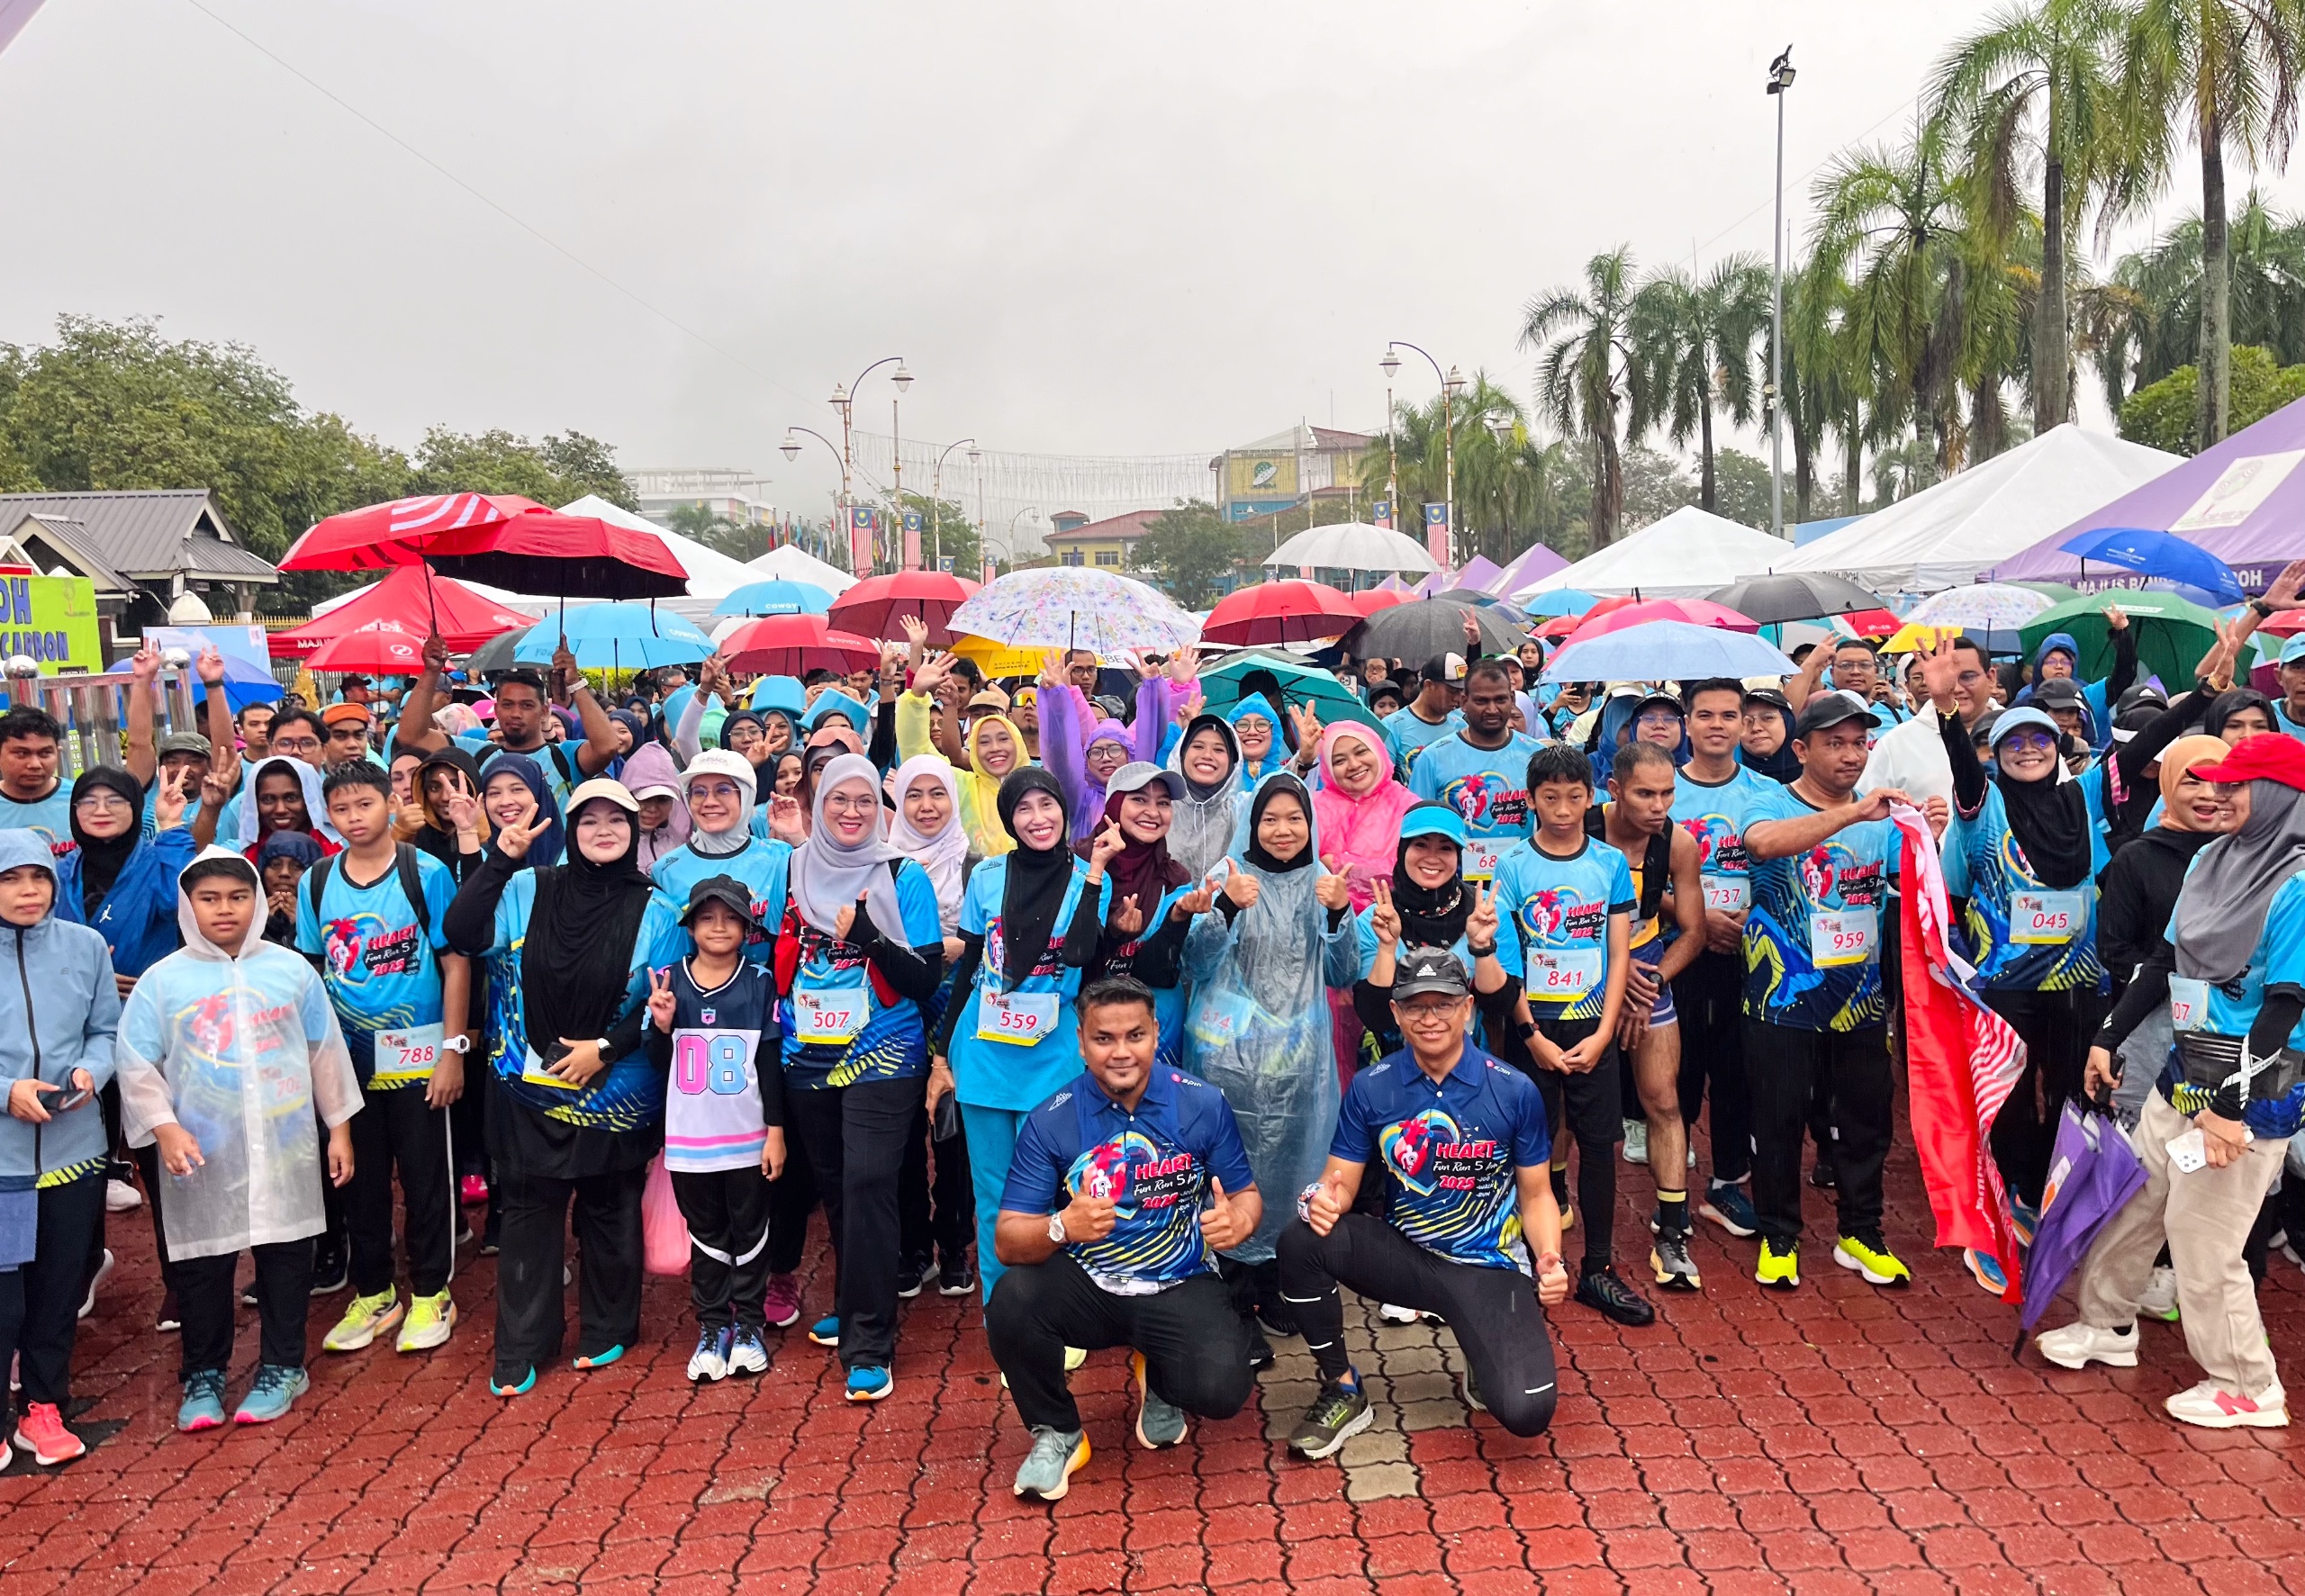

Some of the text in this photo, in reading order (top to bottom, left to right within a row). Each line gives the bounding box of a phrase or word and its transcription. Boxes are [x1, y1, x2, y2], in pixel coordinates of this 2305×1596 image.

[1, 630, 69, 663] CARBON
[1494, 789, 1527, 802] HEAR
[1479, 855, 1497, 868] 68
[1710, 888, 1740, 906] 737
[1567, 900, 1605, 917] HEART
[1592, 915, 1598, 923] 5
[2032, 913, 2068, 929] 045
[367, 923, 419, 951] HEART
[1570, 927, 1594, 939] 2025
[1834, 931, 1865, 949] 959
[402, 942, 411, 952] 5
[374, 959, 405, 977] 2025
[1547, 971, 1583, 987] 841
[813, 1011, 850, 1029] 507
[2171, 1002, 2191, 1021] 07
[999, 1011, 1037, 1032] 559
[398, 1045, 434, 1065] 788
[676, 1034, 747, 1095] 08
[1435, 1140, 1497, 1159] HEART
[1134, 1153, 1192, 1180] HEART
[1433, 1160, 1450, 1172] Fun
[1451, 1161, 1471, 1172] Run
[1474, 1160, 1484, 1171] 5
[1134, 1183, 1152, 1196] Fun
[1153, 1179, 1173, 1192] Run
[1176, 1173, 1186, 1186] 5
[1439, 1175, 1476, 1191] 2025
